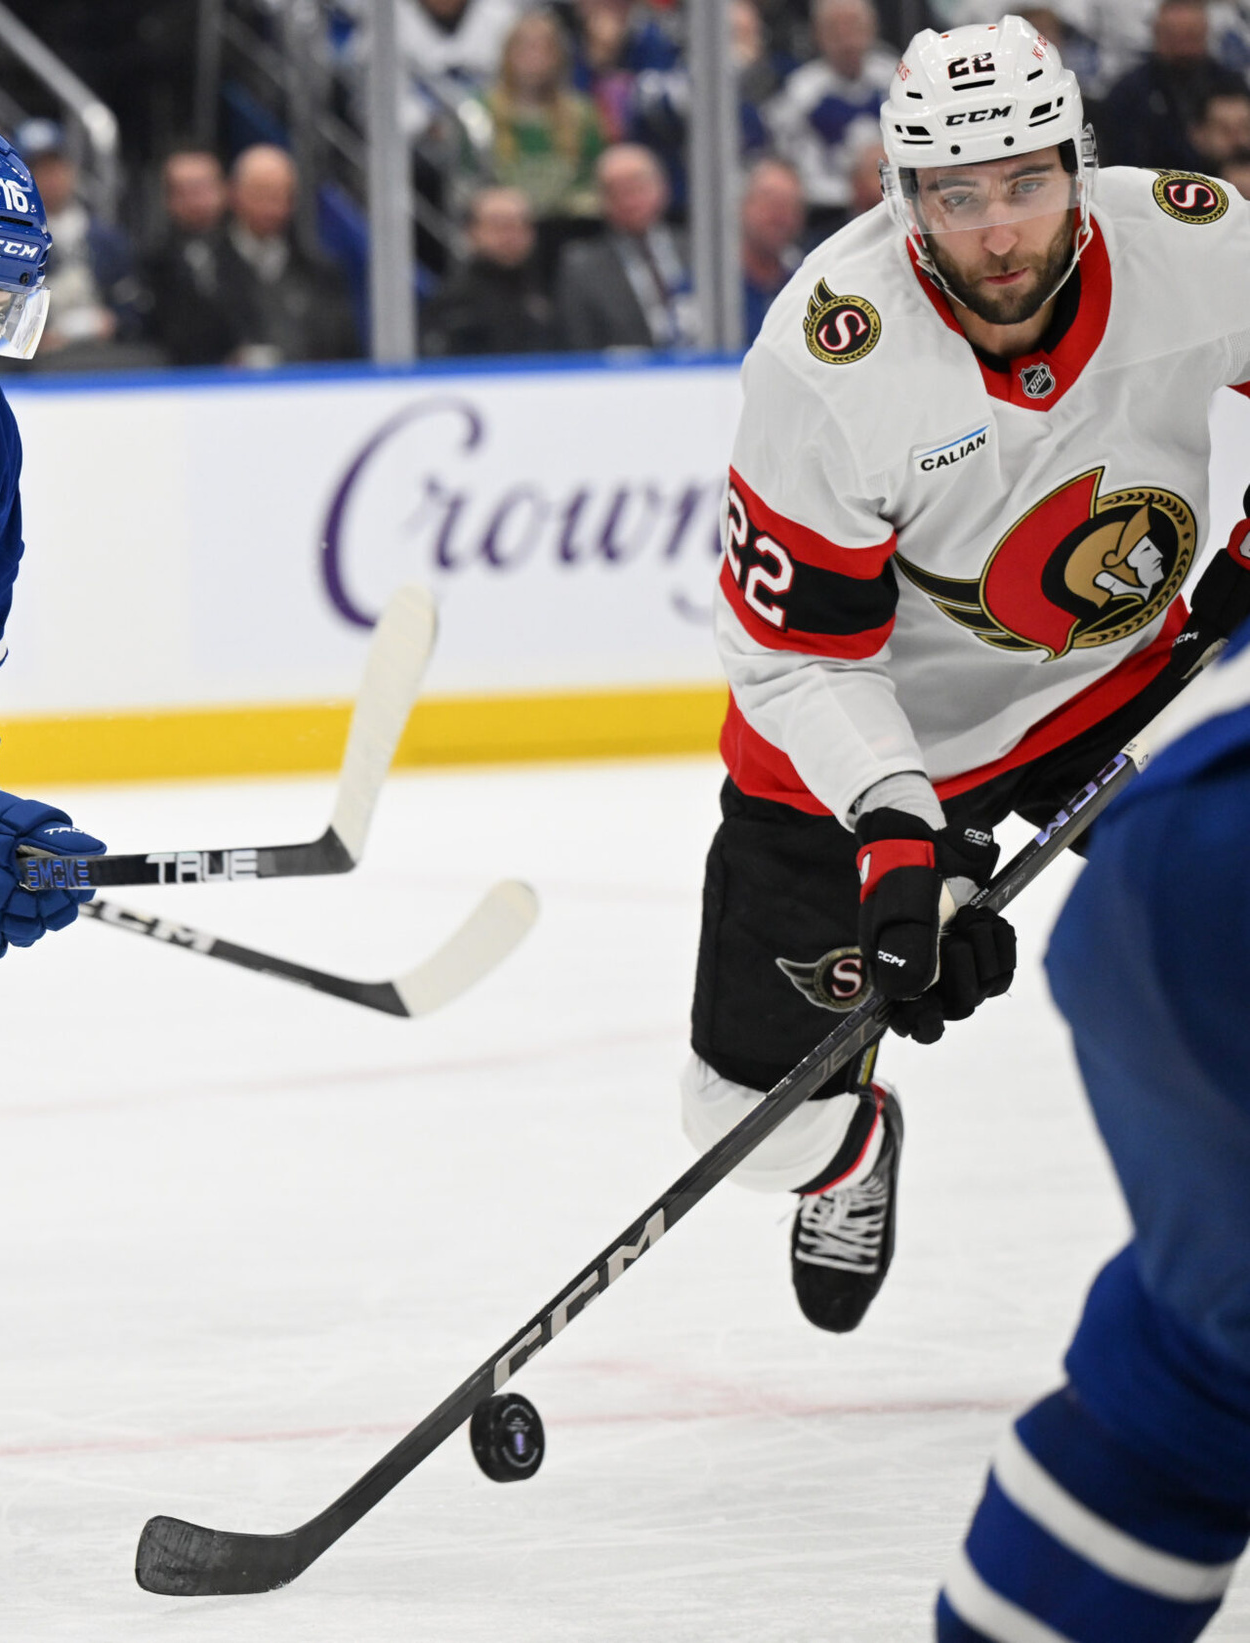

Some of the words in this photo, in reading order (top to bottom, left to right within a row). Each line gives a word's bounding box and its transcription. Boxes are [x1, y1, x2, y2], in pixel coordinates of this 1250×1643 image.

[945, 105, 1012, 127] CCM
[1029, 369, 1048, 393] NHL
[920, 433, 987, 472] CALIAN
[726, 486, 795, 631] 22
[964, 827, 993, 843] CCM
[146, 849, 258, 885] TRUE
[492, 1208, 665, 1392] CCM
